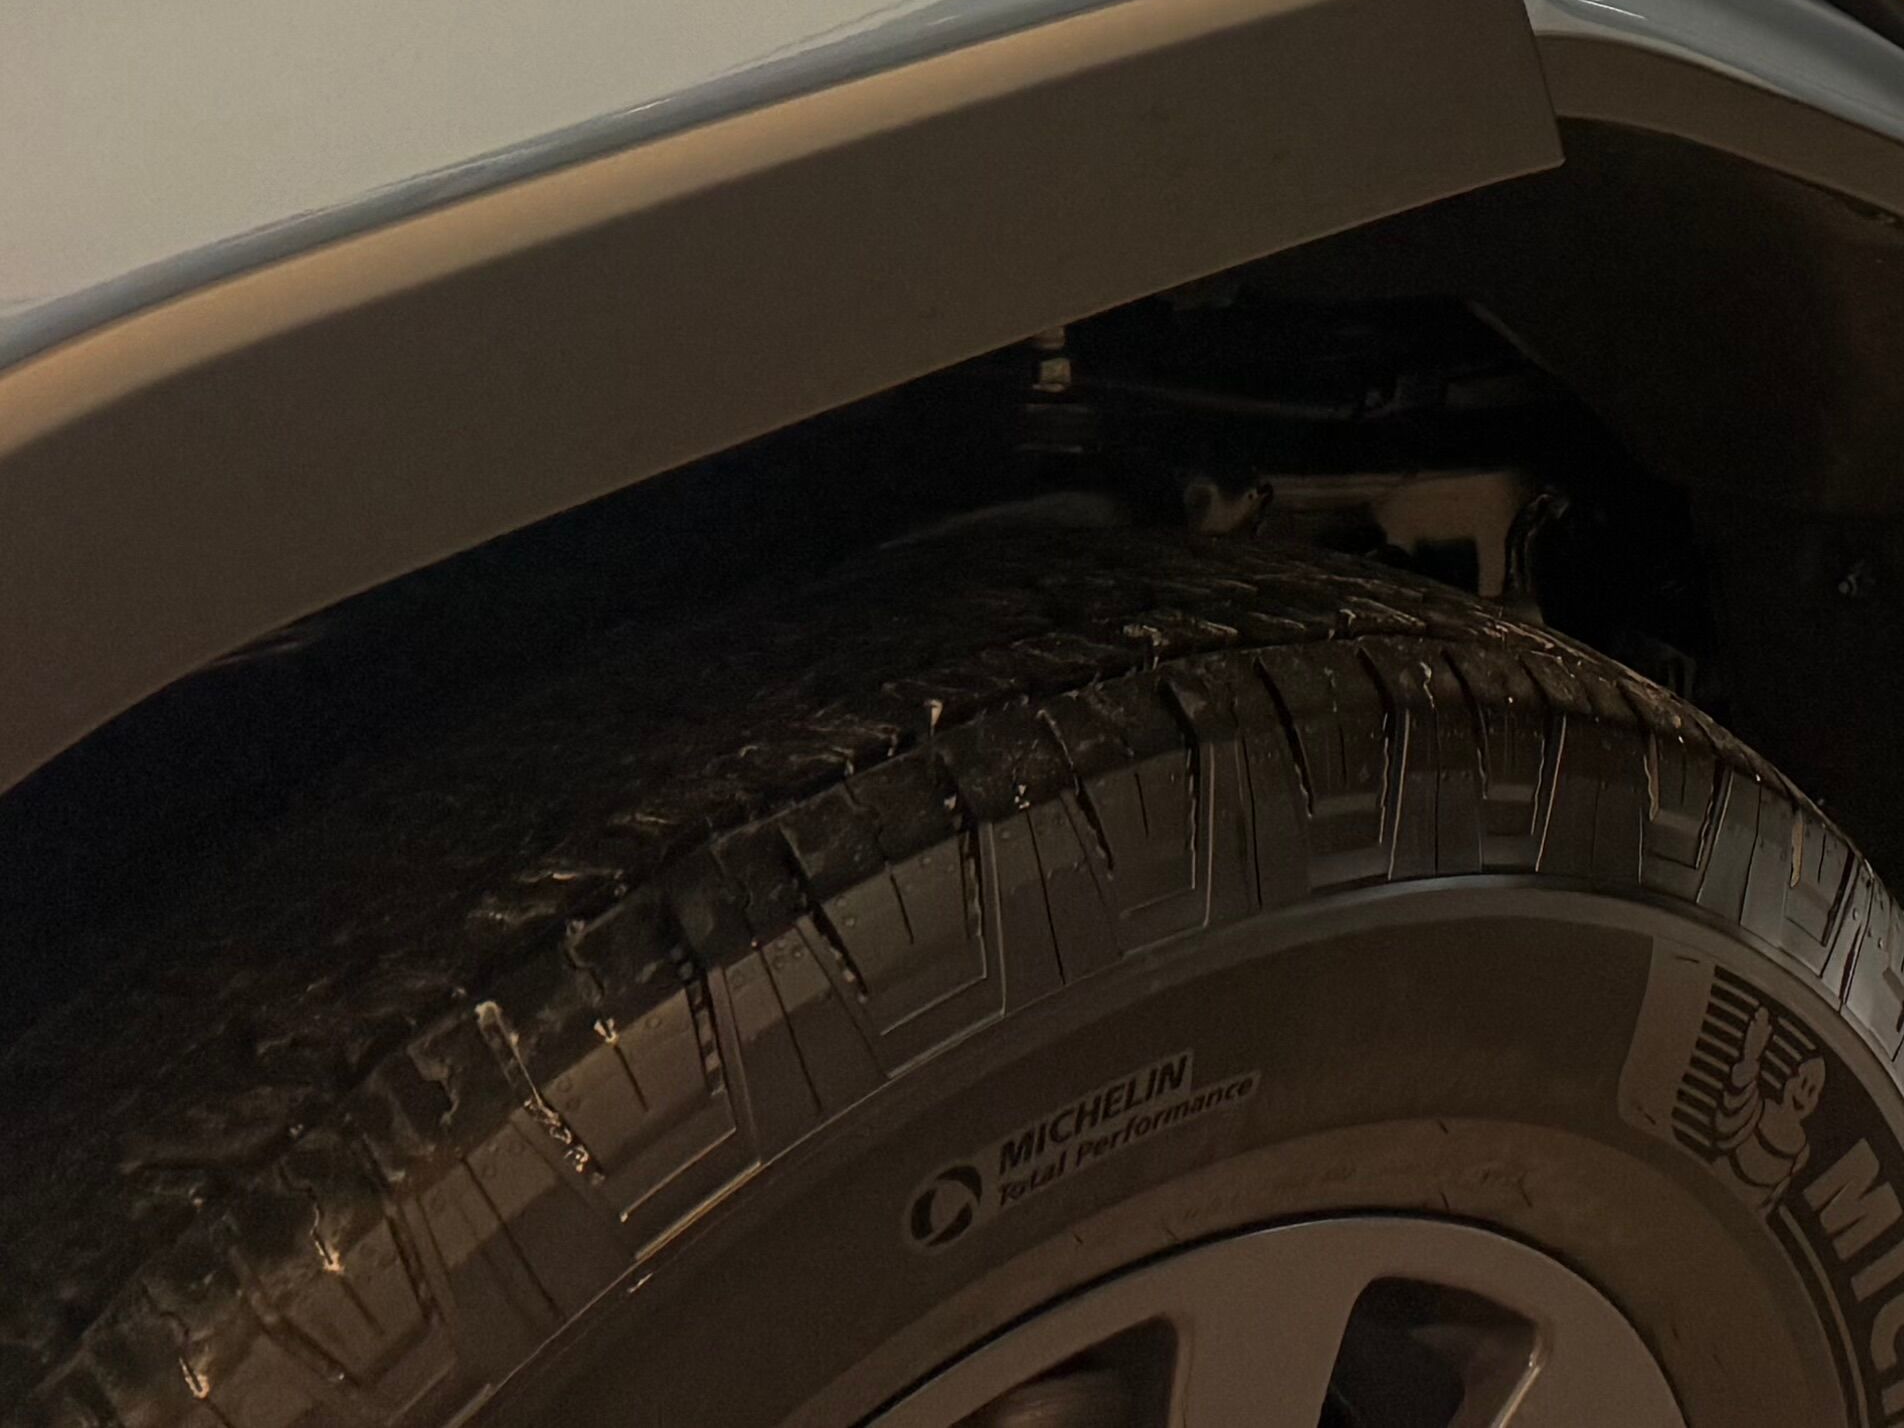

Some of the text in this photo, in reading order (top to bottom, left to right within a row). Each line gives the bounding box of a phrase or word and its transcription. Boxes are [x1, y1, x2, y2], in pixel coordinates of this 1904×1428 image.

[998, 1054, 1188, 1176] MICHELIN
[998, 1076, 1255, 1206] Total Performance
